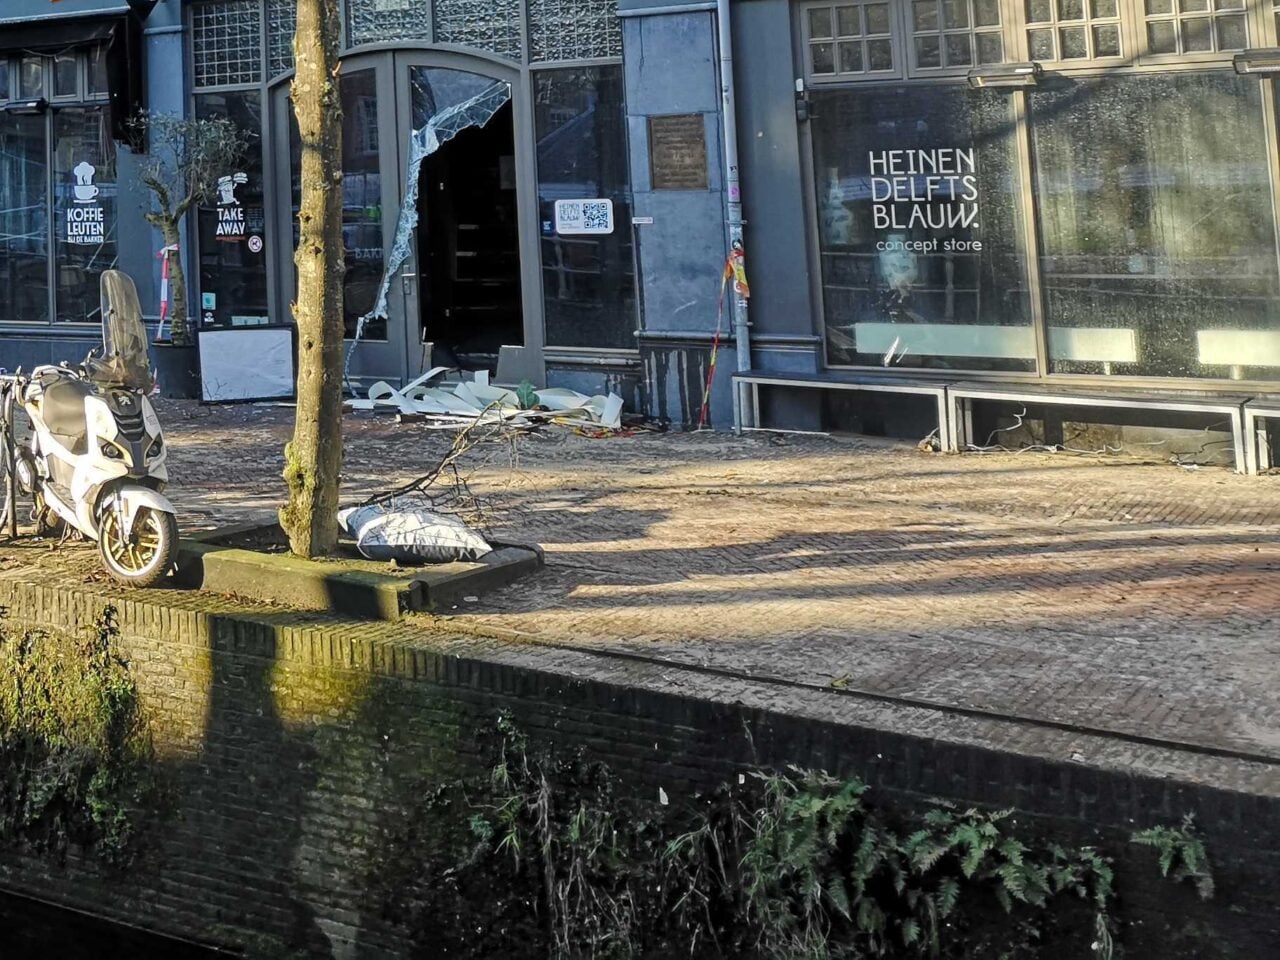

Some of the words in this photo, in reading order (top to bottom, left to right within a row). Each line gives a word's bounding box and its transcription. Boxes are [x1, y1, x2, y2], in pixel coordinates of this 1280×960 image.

[869, 148, 975, 175] HEINEN
[871, 175, 978, 202] DELFTS
[67, 208, 104, 221] KOFFIE
[216, 208, 244, 221] TAKE
[873, 203, 979, 229] BLAUW.
[67, 222, 104, 235] LEUTEN
[216, 222, 245, 235] AWAY
[876, 238, 937, 255] concept
[943, 238, 982, 251] store
